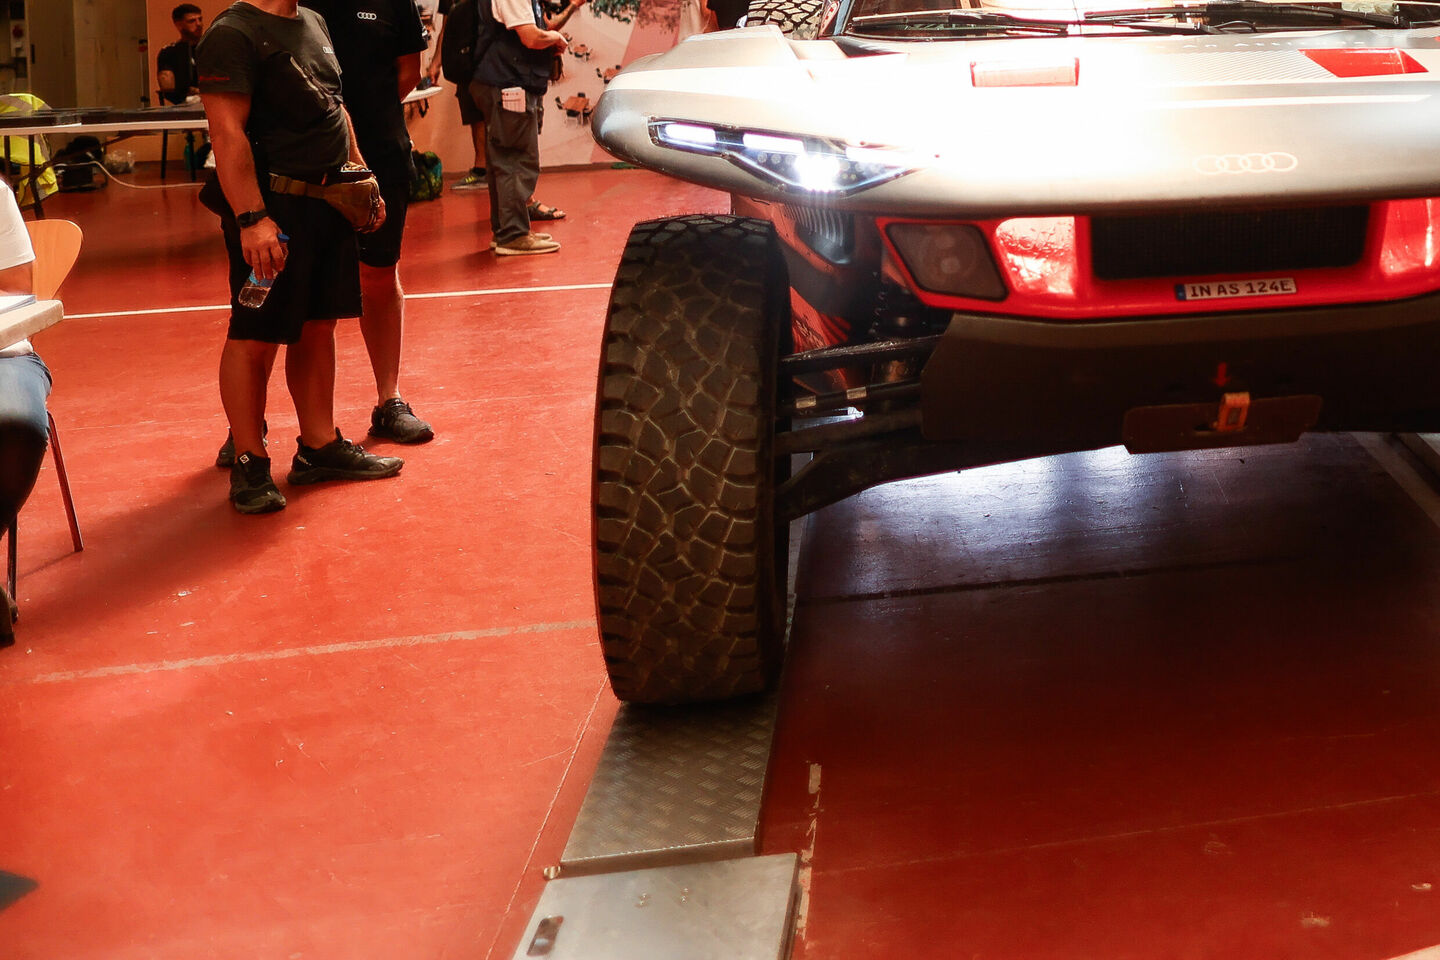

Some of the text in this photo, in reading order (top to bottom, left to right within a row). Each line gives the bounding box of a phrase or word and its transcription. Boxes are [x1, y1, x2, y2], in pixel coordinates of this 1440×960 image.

[1190, 279, 1293, 298] IN AS 124E
